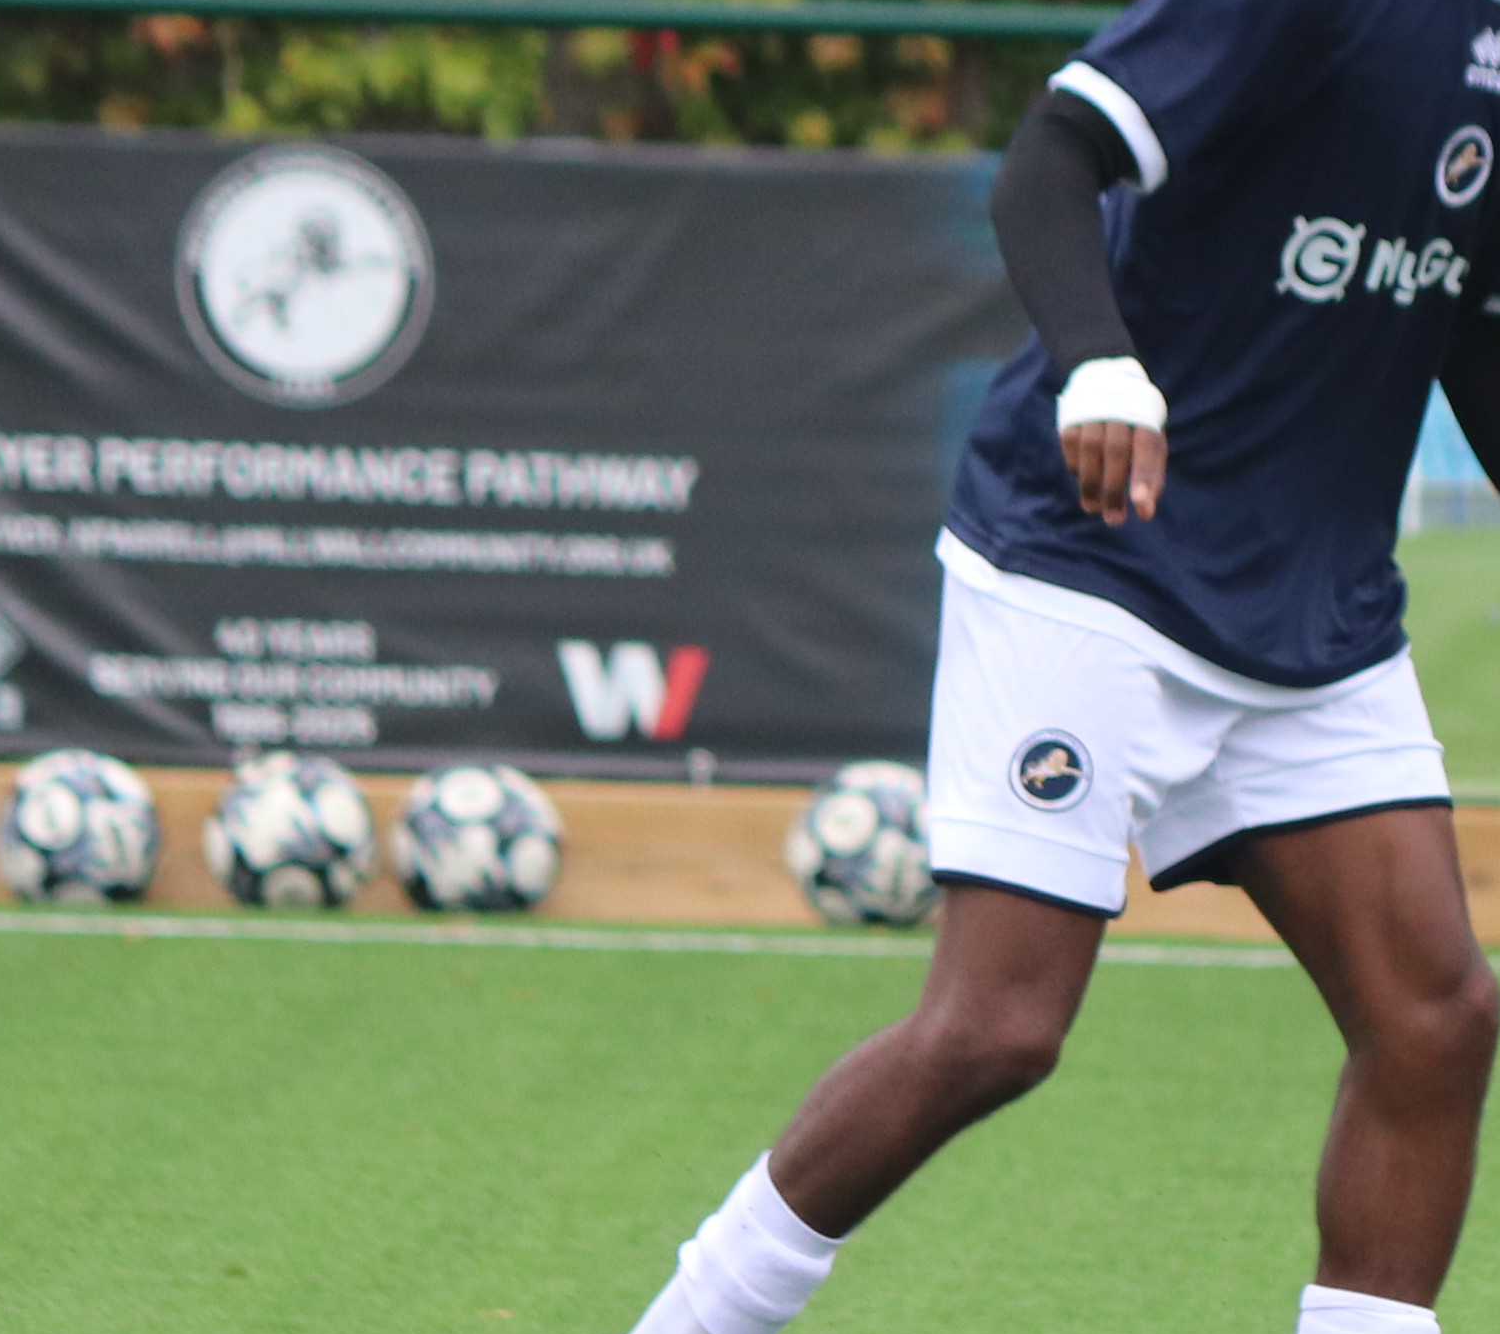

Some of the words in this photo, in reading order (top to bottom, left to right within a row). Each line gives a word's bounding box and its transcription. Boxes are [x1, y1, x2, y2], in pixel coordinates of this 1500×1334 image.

[98, 435, 462, 508] PERFORMANCE
[463, 447, 700, 513] PATHWAY
[302, 663, 501, 711] COMMUNITY
